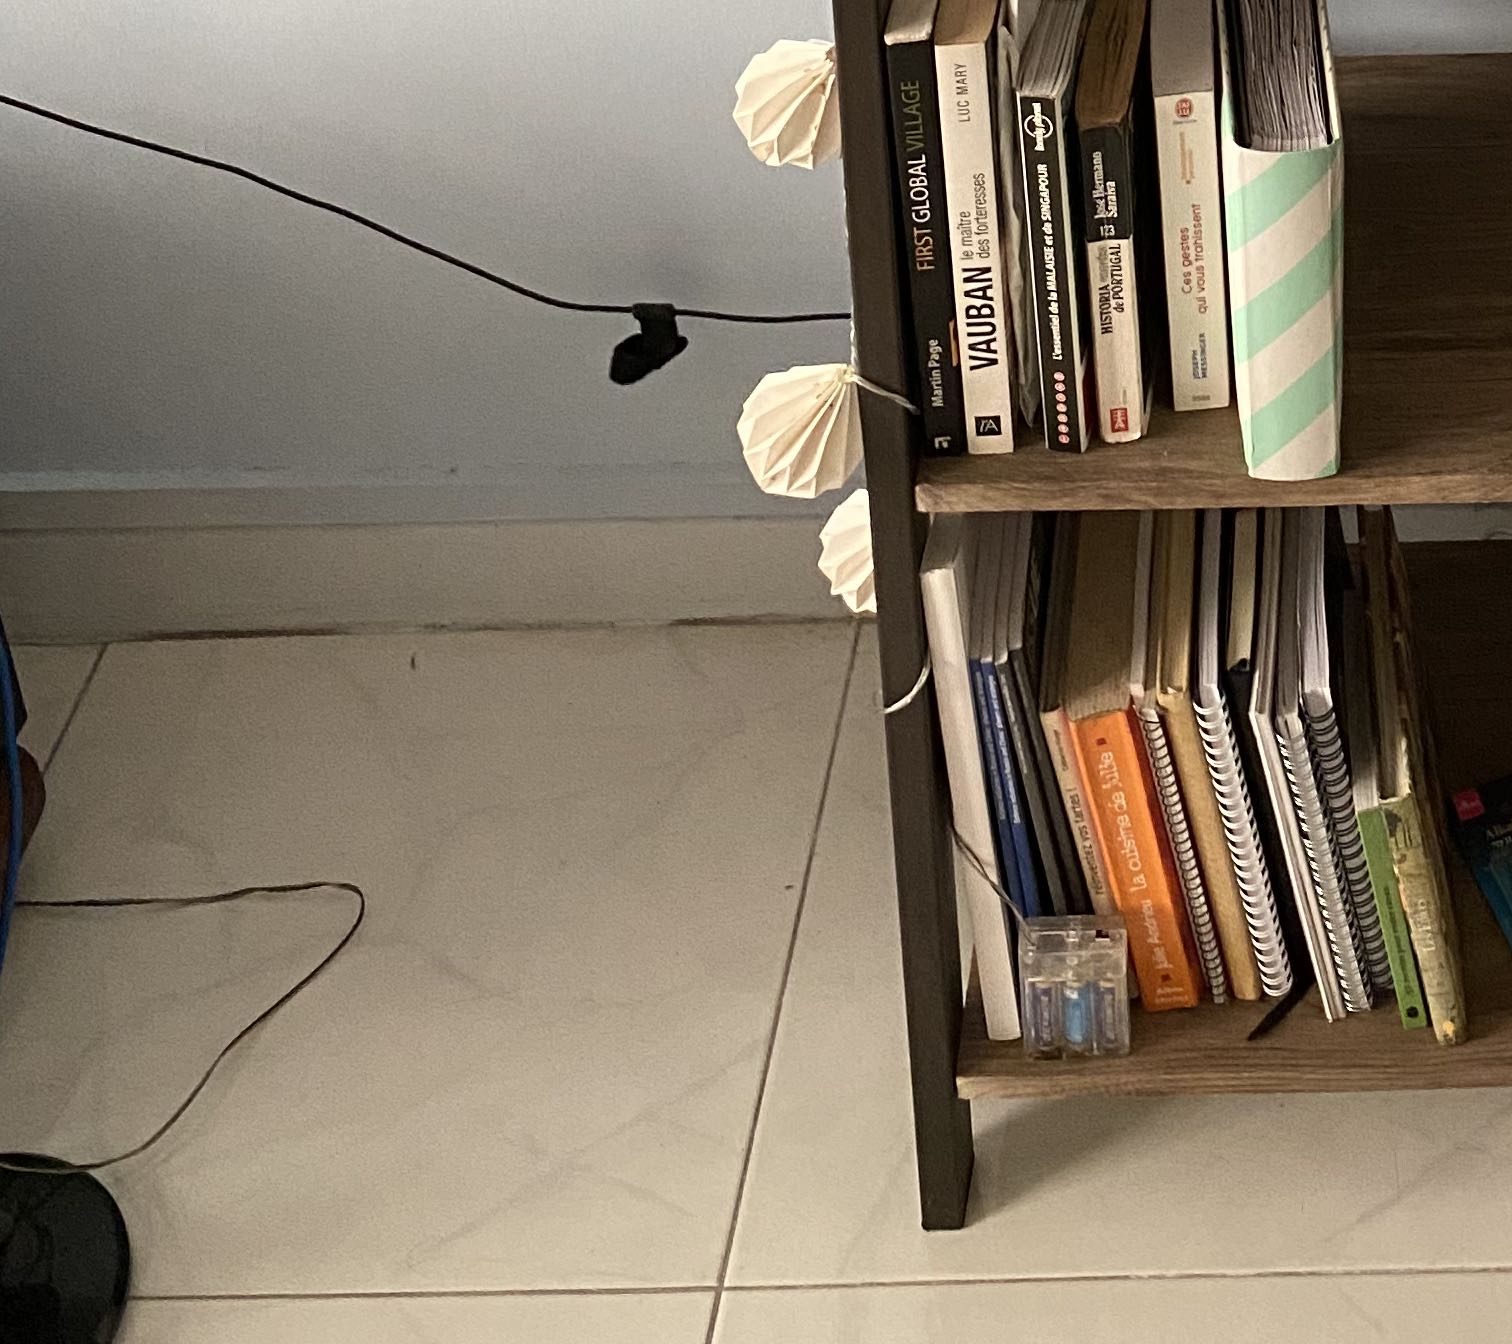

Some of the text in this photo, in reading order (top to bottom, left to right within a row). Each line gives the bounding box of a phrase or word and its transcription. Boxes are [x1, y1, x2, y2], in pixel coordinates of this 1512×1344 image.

[1036, 163, 1053, 222] SINGAPOUR
[1090, 151, 1104, 198] Hermano
[1104, 180, 1118, 219] Saraiva
[955, 62, 1000, 372] VAUBAN LUC MARY
[956, 210, 974, 261] le maître
[972, 172, 991, 259] des forteresses
[1042, 222, 1053, 235] de
[900, 79, 945, 408] Martin Page FIRST GLOBAL VILLAGE
[1043, 246, 1057, 291] MALAISIE
[1180, 226, 1193, 295] Ces gestes
[1191, 202, 1209, 315] qui vous trahissent
[1108, 243, 1125, 313] de PORTUGAL
[1048, 302, 1060, 314] de
[1099, 283, 1114, 336] HISTORIA
[1050, 314, 1064, 361] L'essentiel
[1110, 790, 1127, 813] de
[1116, 812, 1143, 873] cuisine
[1129, 872, 1148, 893] la
